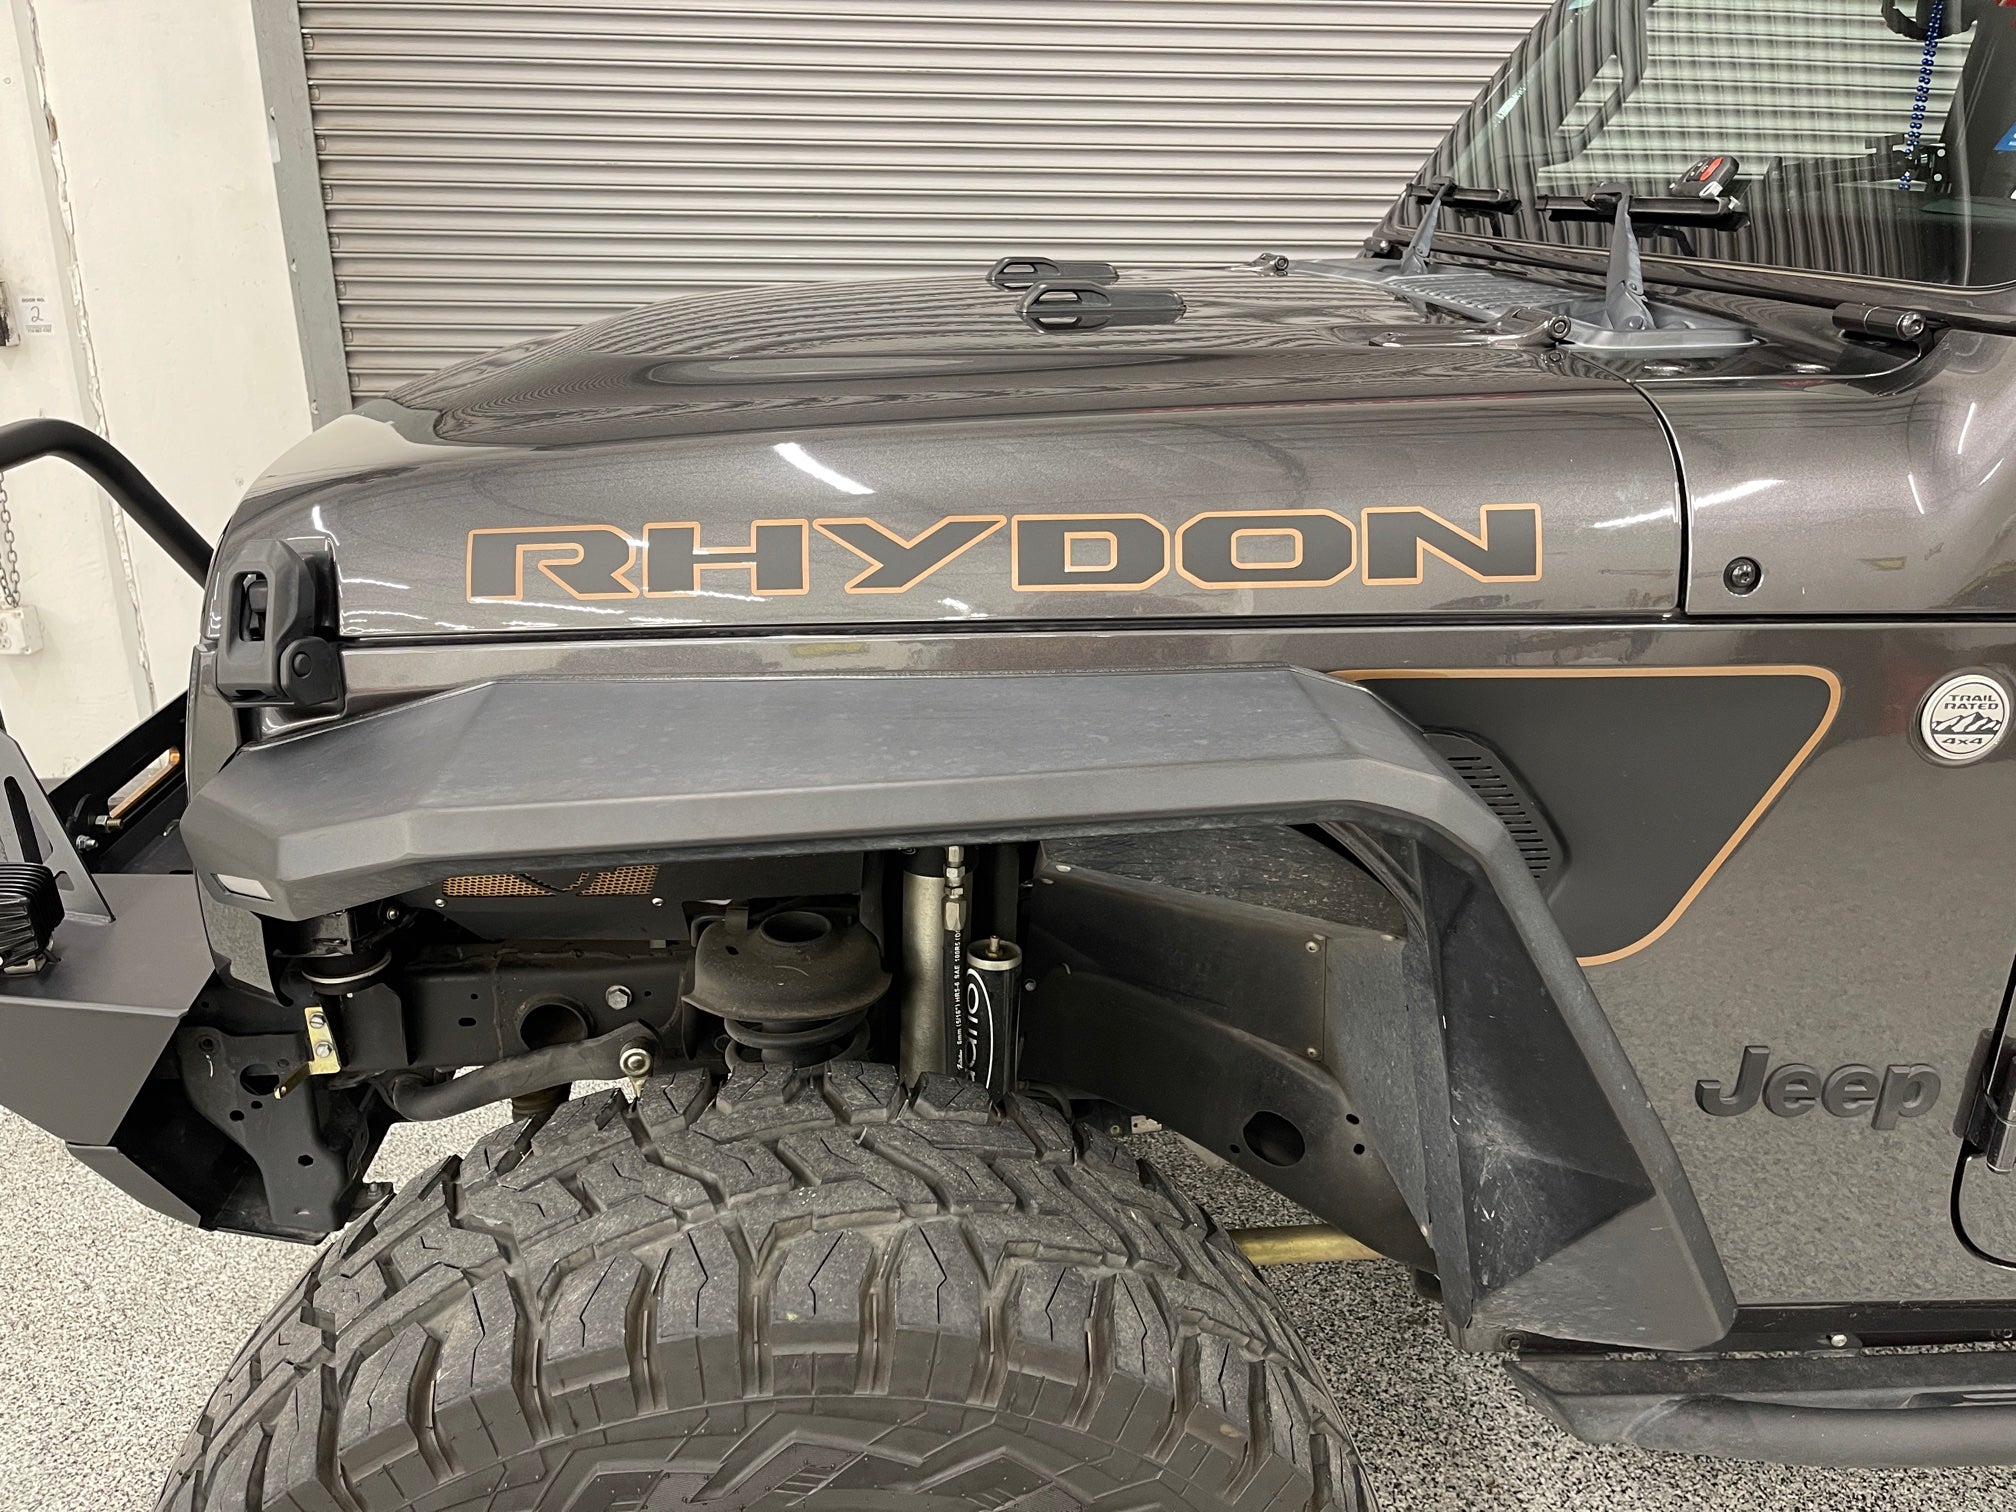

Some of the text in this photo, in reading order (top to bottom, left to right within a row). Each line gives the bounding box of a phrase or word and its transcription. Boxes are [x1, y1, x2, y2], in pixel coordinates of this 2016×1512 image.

[30, 305, 44, 323] 2
[466, 503, 1542, 603] RHYDON
[1949, 694, 1997, 702] TRAIL
[1944, 702, 1999, 710] RATED
[1942, 737, 1983, 745] 4x4
[1695, 1045, 1941, 1130] Jeep
